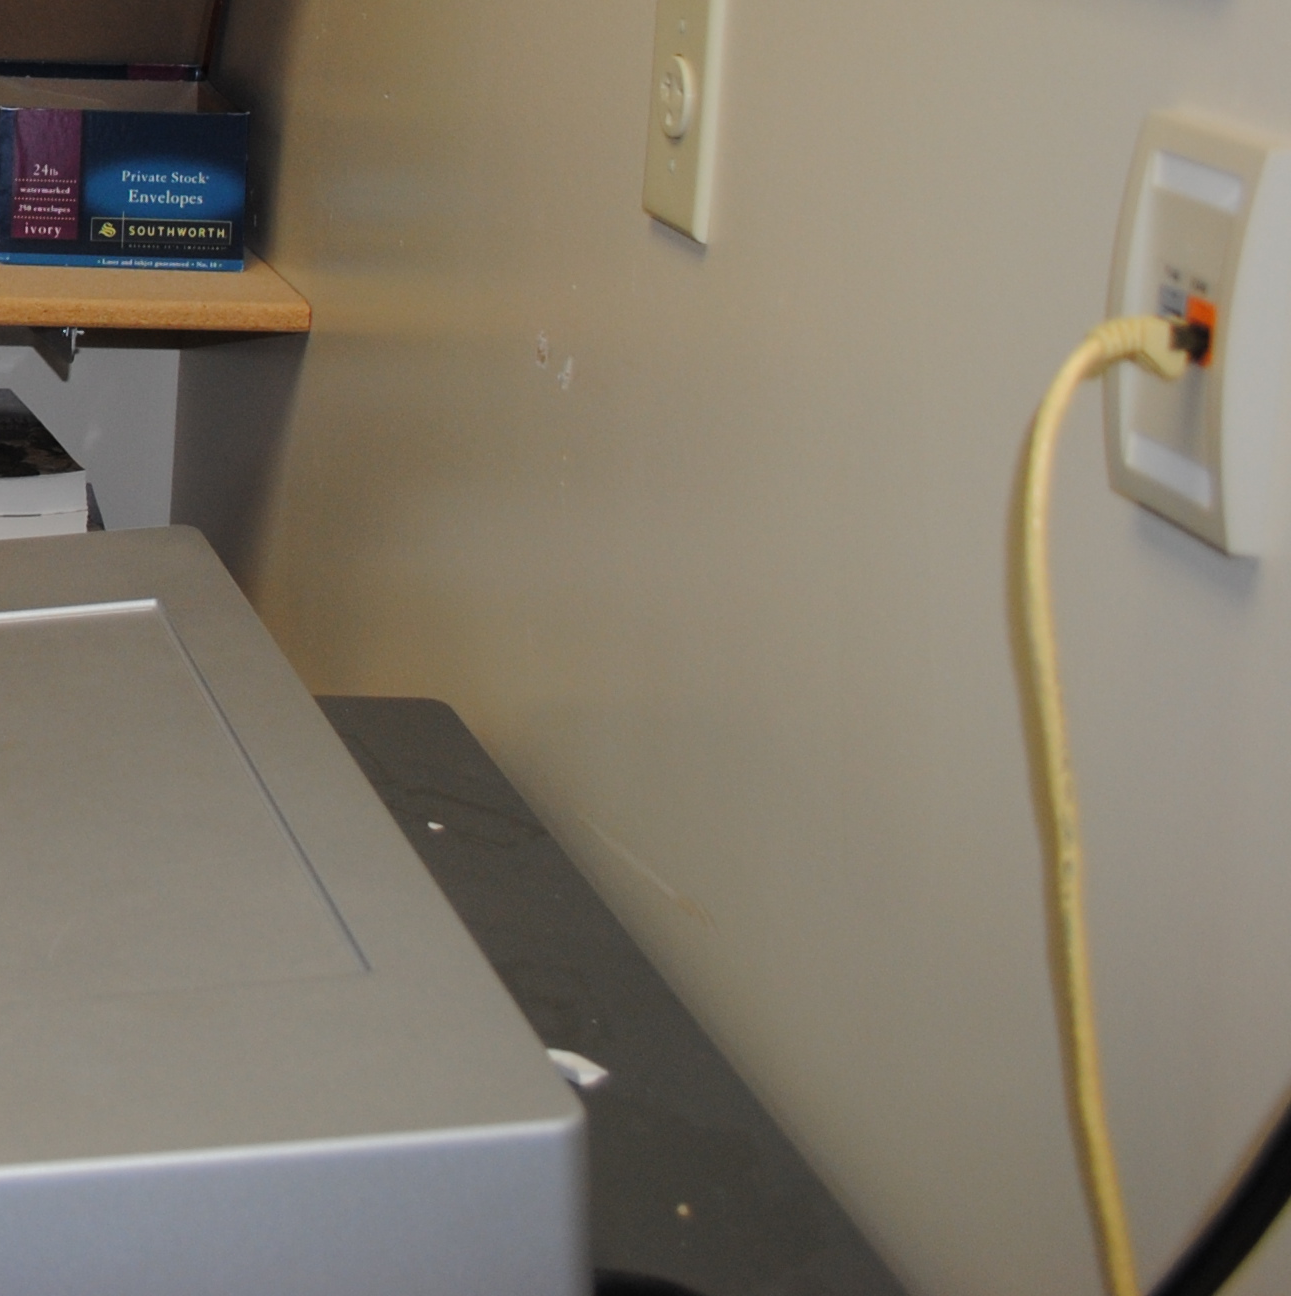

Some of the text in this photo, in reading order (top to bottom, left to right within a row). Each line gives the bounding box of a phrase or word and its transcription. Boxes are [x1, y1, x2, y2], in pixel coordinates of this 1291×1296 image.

[121, 170, 167, 183] Private
[20, 186, 71, 194] watermarked
[128, 189, 203, 208] Envelopes
[33, 205, 71, 214] envelopes
[24, 222, 62, 238] ivory
[128, 225, 226, 238] SOUTHWORTH
